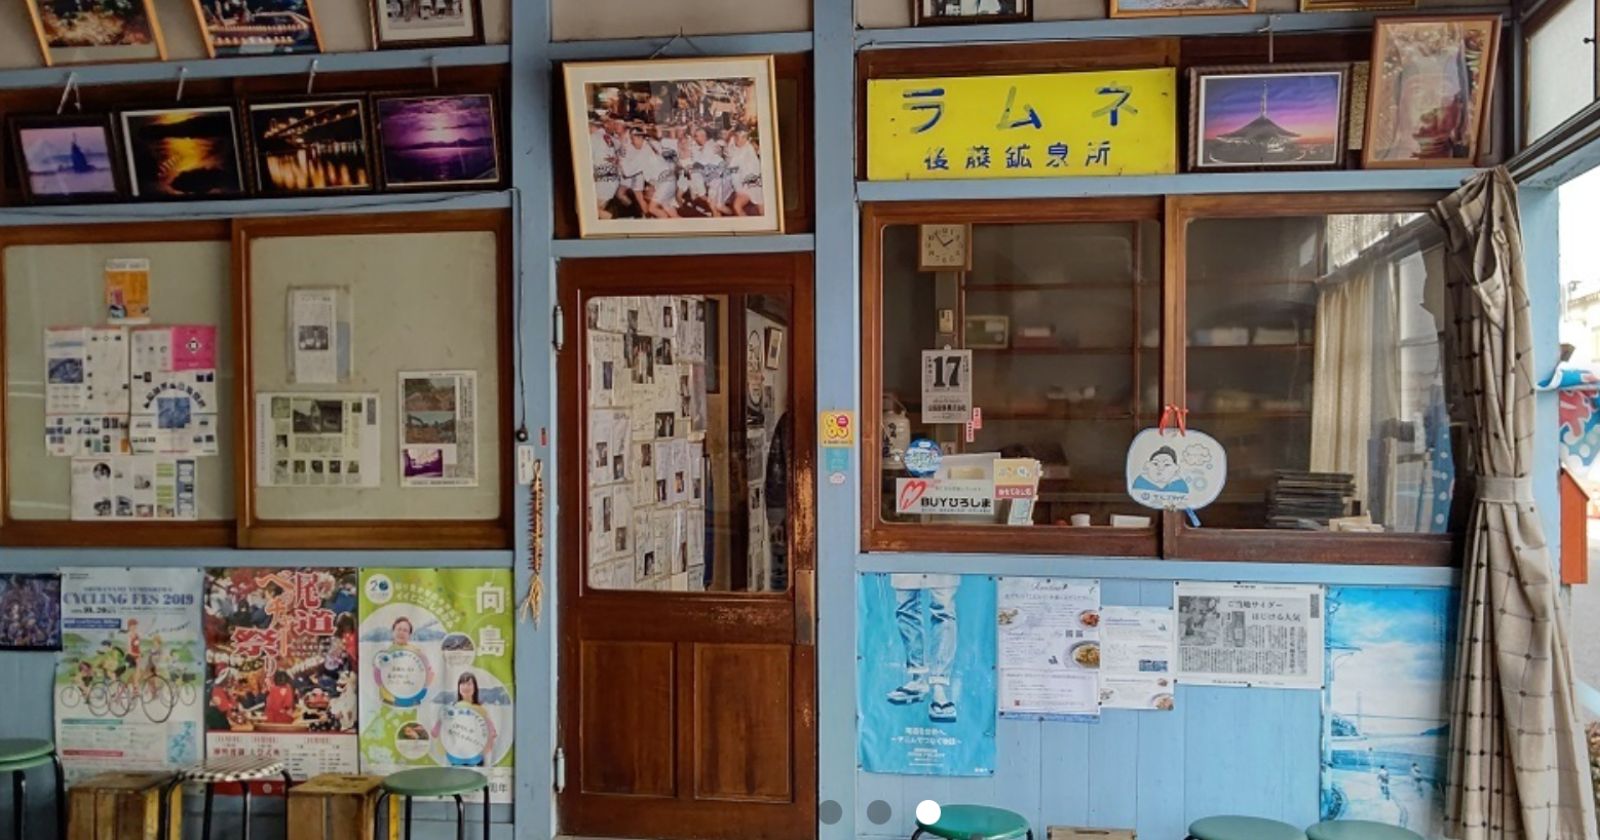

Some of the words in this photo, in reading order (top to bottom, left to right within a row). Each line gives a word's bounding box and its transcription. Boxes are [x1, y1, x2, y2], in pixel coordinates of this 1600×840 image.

[902, 81, 1138, 133] ラムネ
[924, 140, 1111, 171] 後藤鉱泉所
[933, 356, 961, 387] 17
[63, 592, 127, 605] CYCLING
[132, 593, 159, 605] FES
[163, 594, 194, 605] 2019
[295, 571, 336, 635] 尾道
[476, 582, 505, 657] 向島
[1252, 613, 1301, 622] はじける人気
